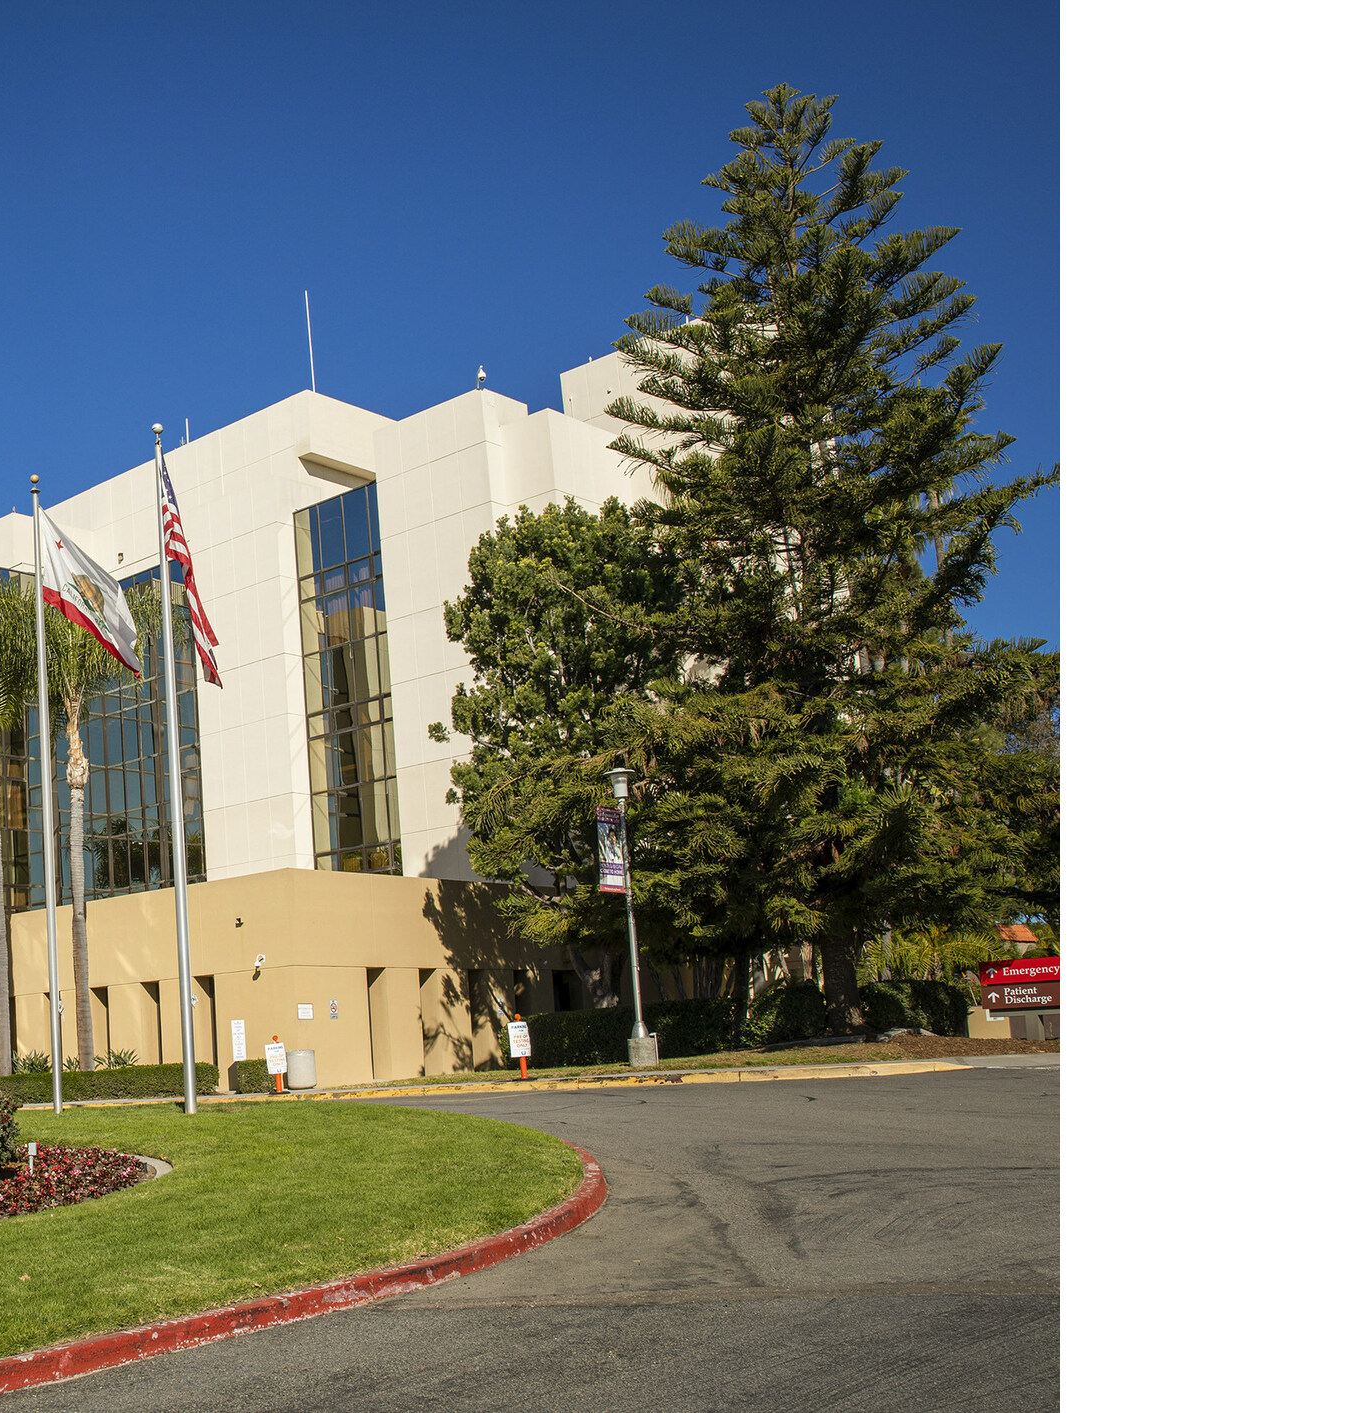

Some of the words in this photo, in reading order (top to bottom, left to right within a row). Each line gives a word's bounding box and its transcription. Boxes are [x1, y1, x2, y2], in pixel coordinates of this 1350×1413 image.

[1002, 965, 1060, 977] Emergency
[1003, 986, 1038, 996] Patient
[1004, 994, 1053, 1004] Discharge
